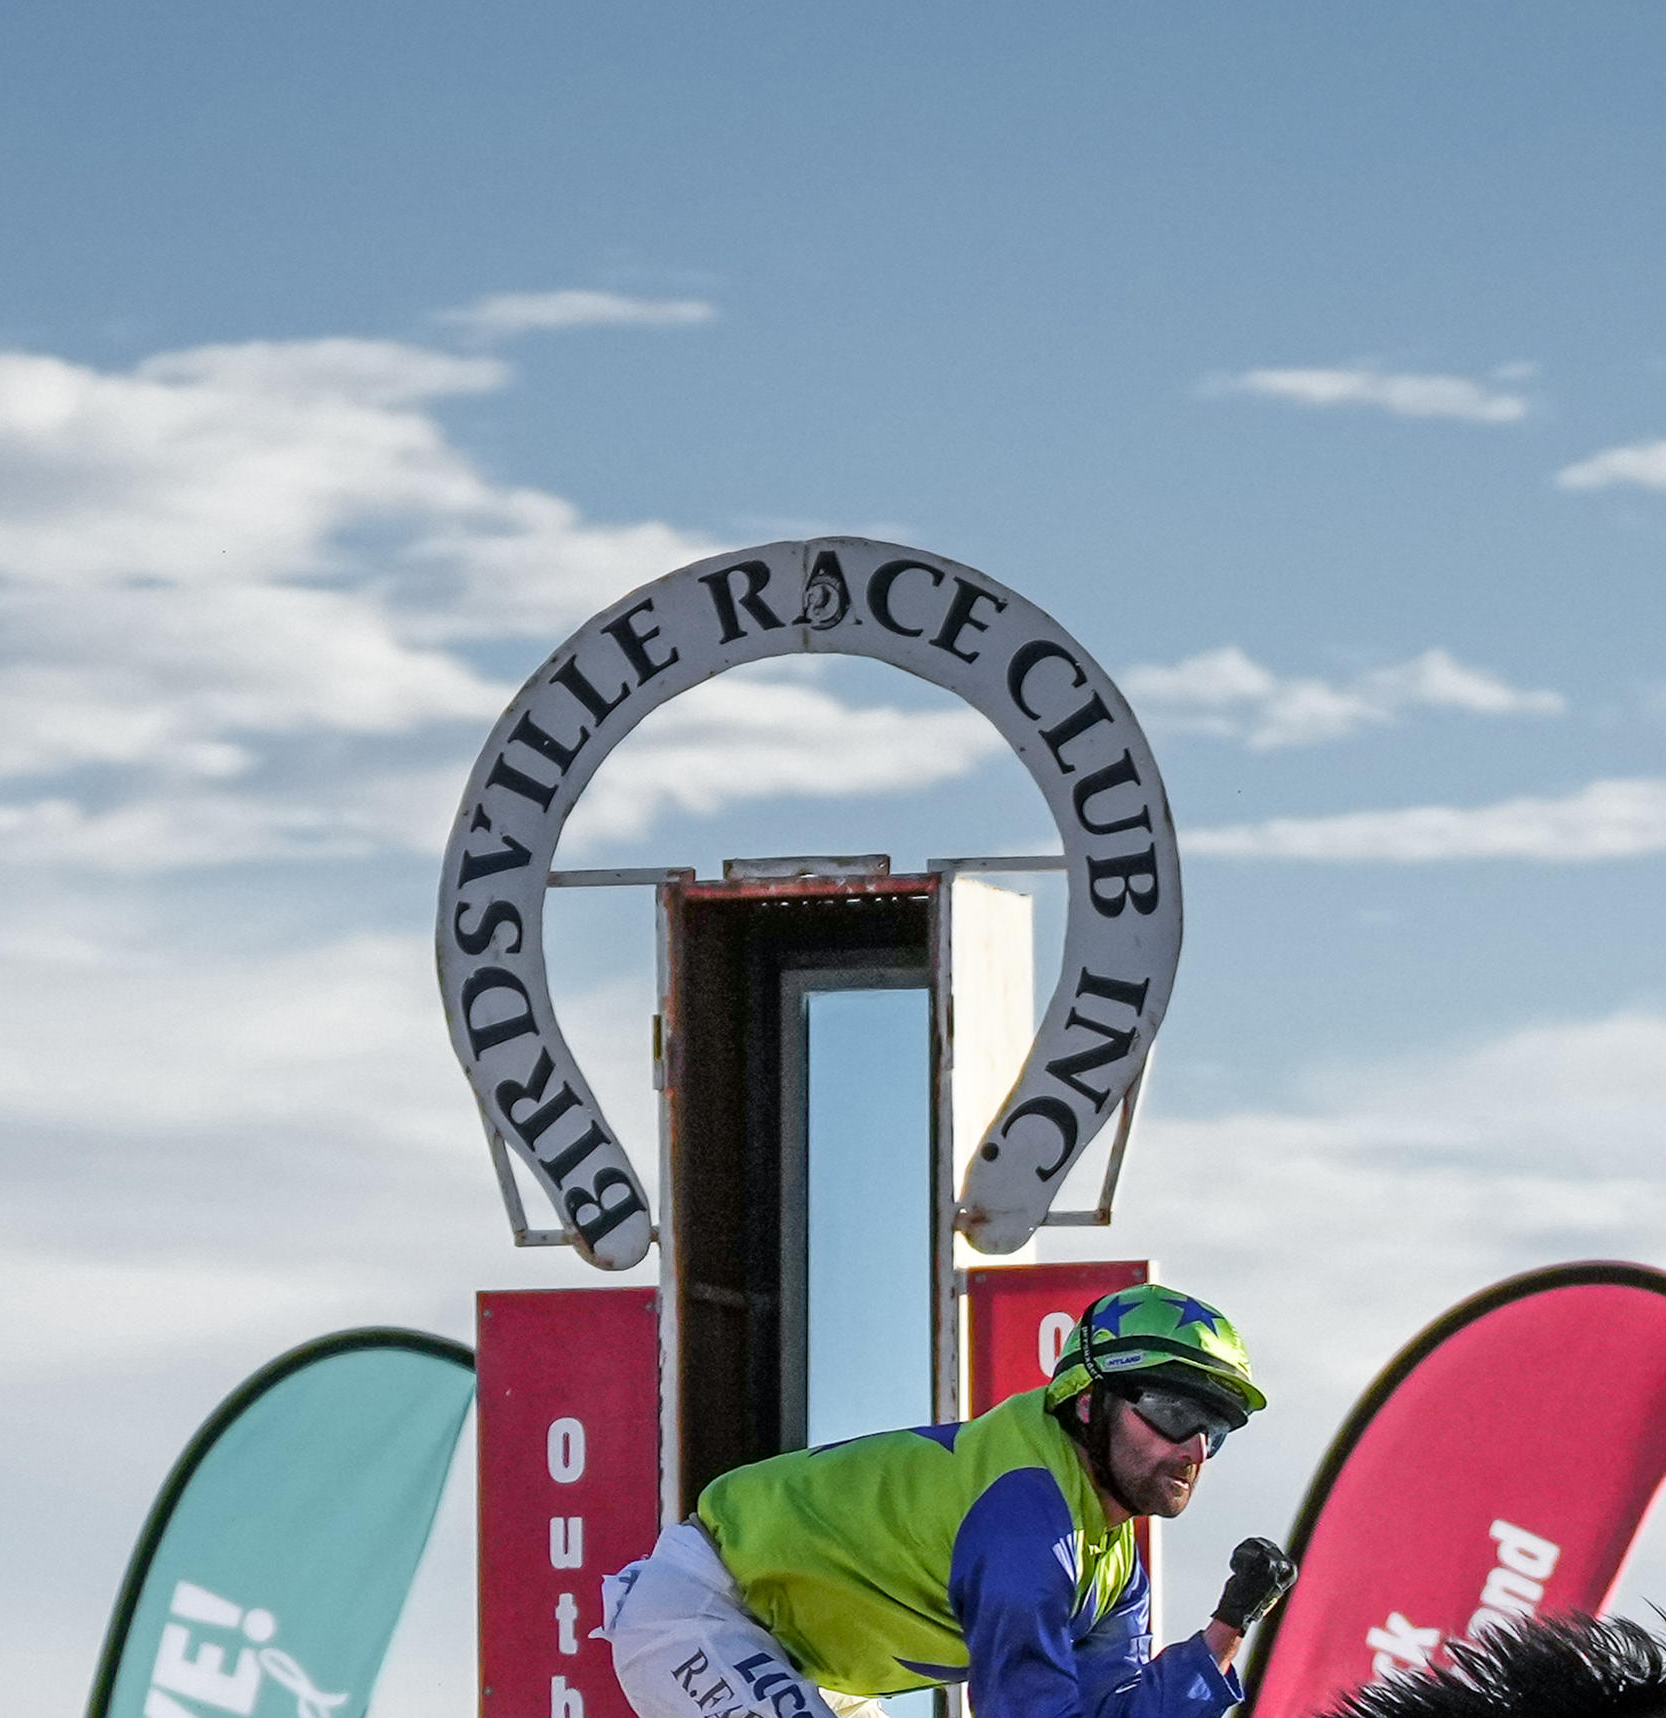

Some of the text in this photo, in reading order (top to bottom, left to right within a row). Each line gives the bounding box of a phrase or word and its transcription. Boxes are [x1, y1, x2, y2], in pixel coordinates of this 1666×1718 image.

[454, 550, 1160, 1250] BIRDSVILLE RACE CLUB INC.
